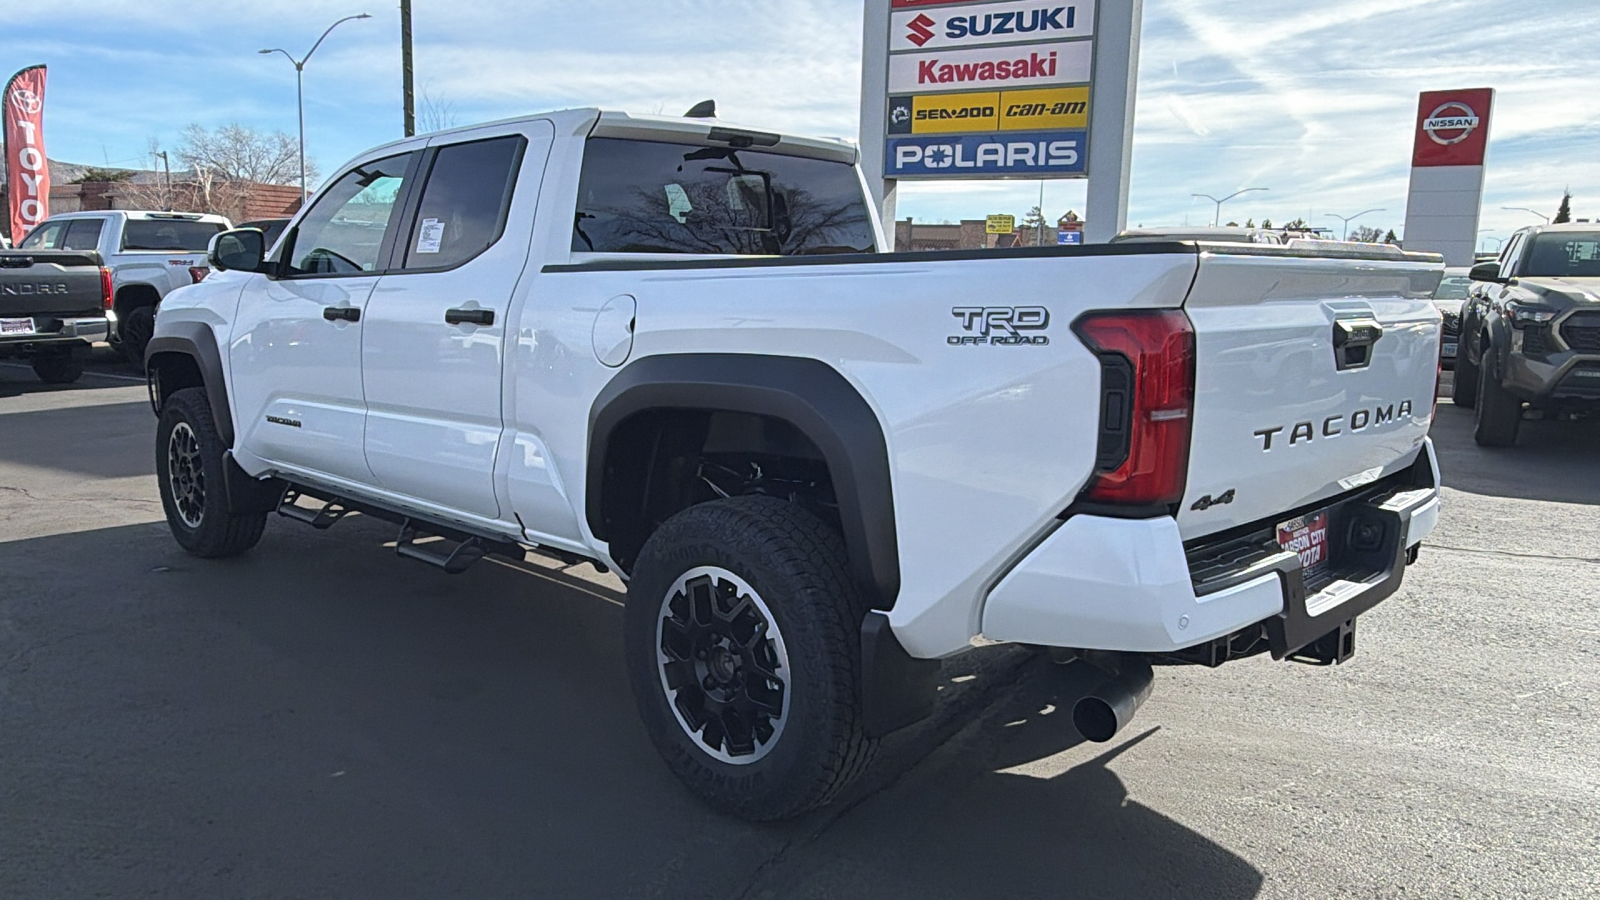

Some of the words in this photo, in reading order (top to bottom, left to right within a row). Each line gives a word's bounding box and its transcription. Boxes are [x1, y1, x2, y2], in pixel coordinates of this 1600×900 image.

[945, 6, 1076, 39] SUZUKI
[918, 51, 1058, 84] Kawasaki
[1428, 118, 1473, 128] NISSAN
[895, 140, 1079, 169] POLARIS
[17, 119, 44, 232] TOYO
[1, 283, 69, 296] NDRA
[951, 305, 1051, 337] TRD
[946, 335, 988, 346] OFF
[989, 335, 1050, 346] ROAD
[1253, 399, 1413, 453] TACOMA
[1311, 528, 1326, 545] CITY
[1298, 545, 1320, 567] YOTA
